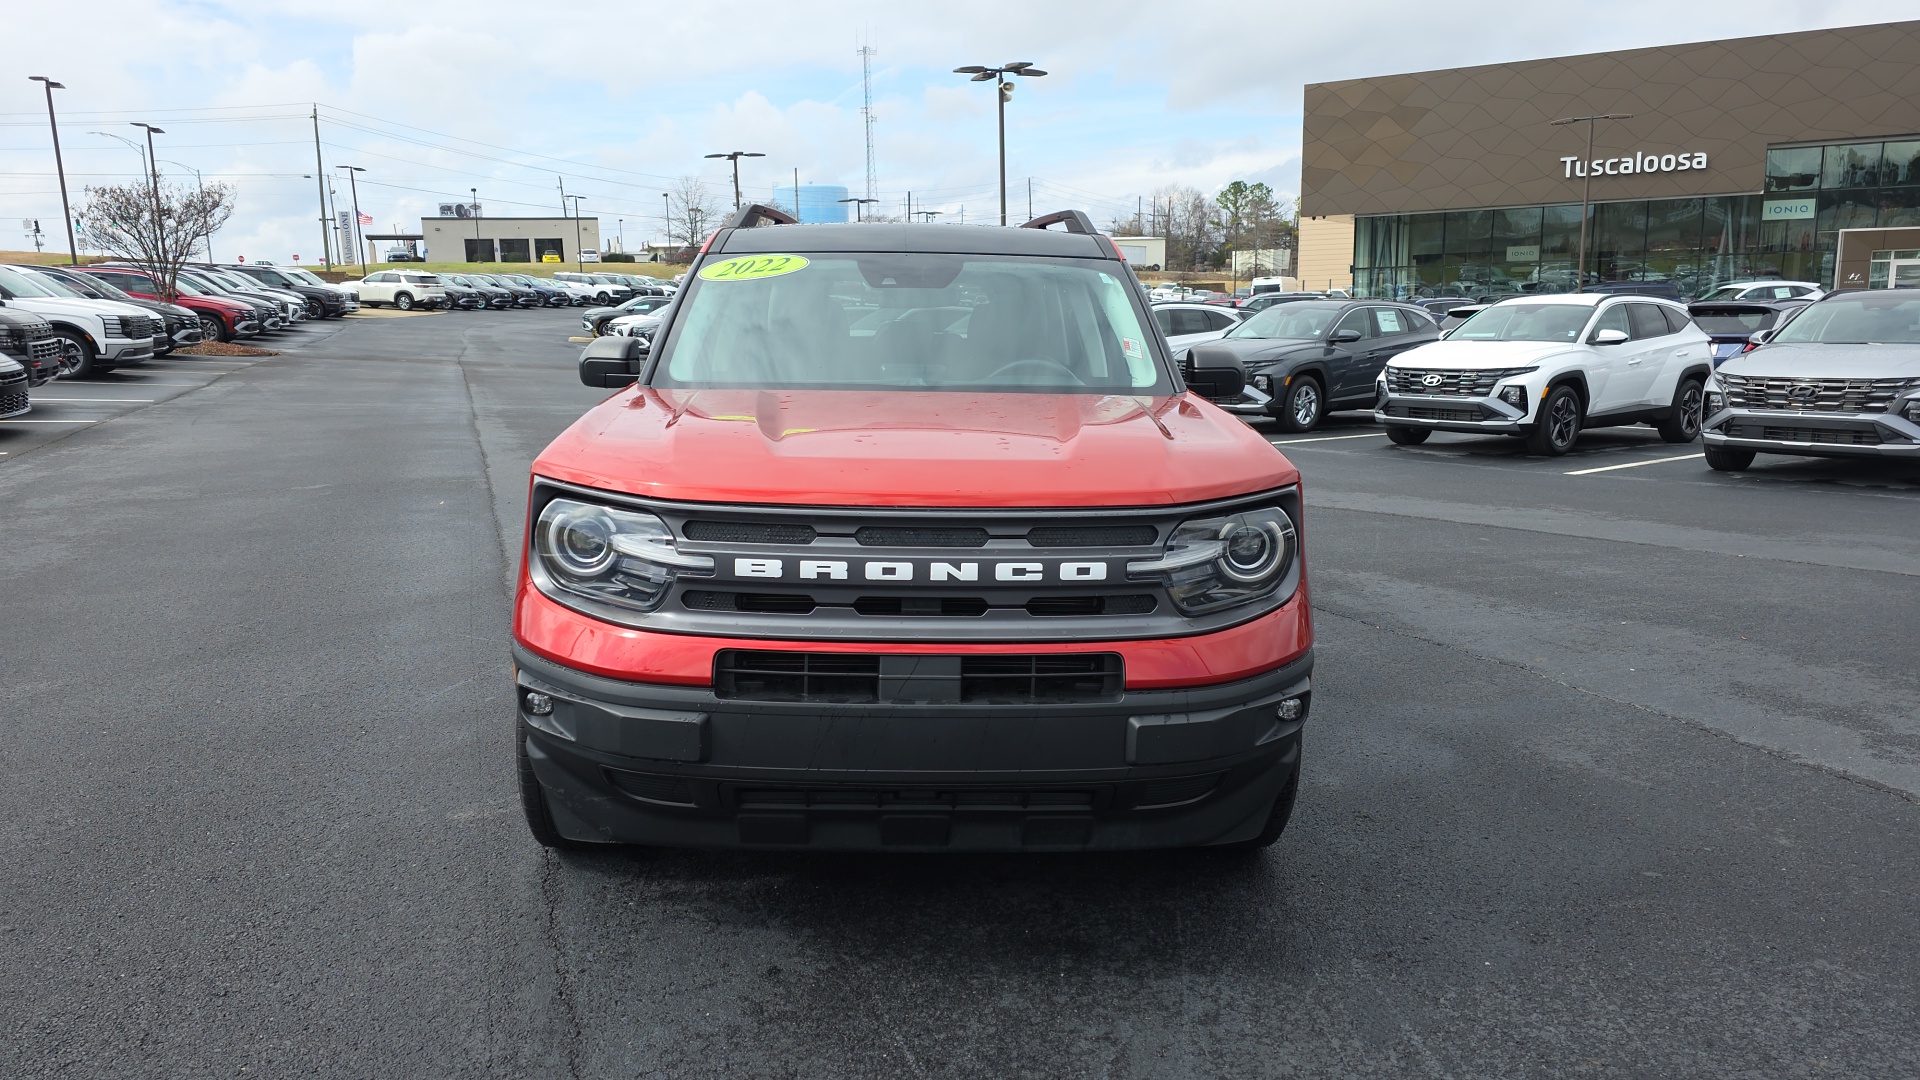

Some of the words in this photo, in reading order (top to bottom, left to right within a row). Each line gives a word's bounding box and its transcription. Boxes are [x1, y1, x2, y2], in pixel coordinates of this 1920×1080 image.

[1560, 151, 1708, 178] Tuscaloosa
[1769, 205, 1809, 214] IONIQ
[340, 211, 350, 230] ONE
[344, 230, 353, 260] Alabama
[714, 257, 791, 278] 2022
[734, 558, 1107, 580] BRONCO
